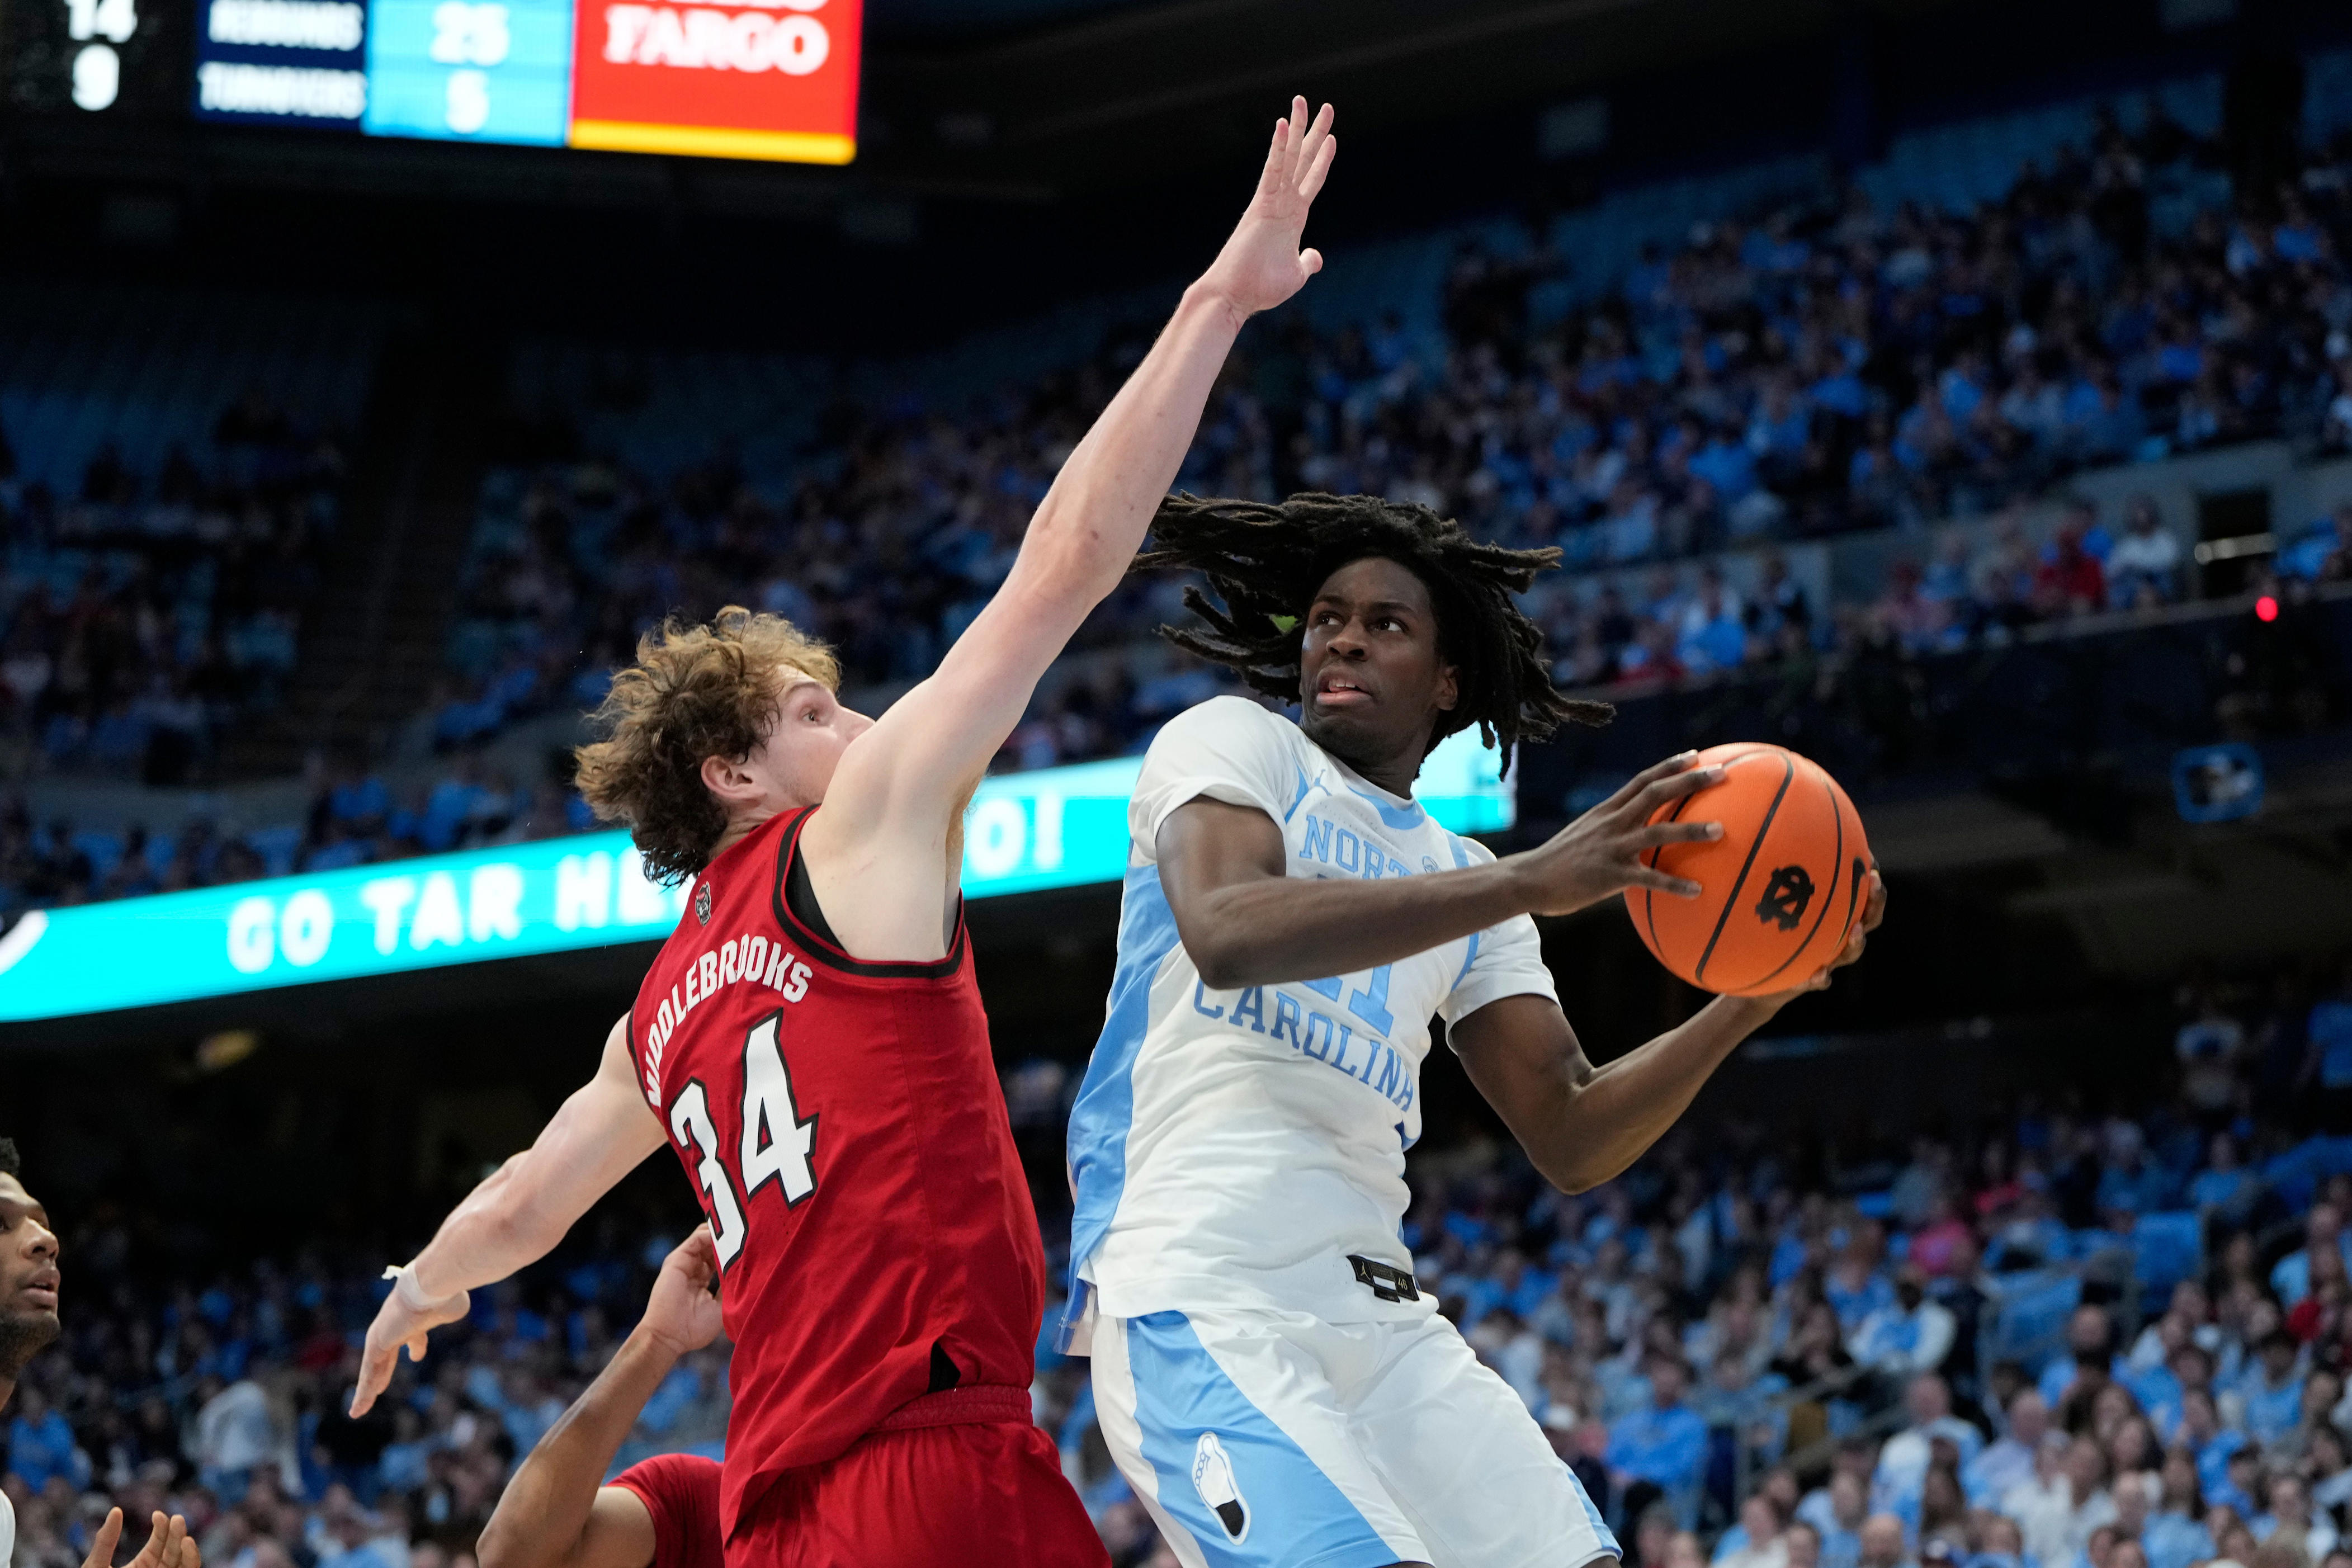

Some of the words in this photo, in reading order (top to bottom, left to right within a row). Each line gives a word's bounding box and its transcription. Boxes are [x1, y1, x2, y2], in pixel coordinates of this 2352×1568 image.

[603, 3, 830, 76] FARGO
[226, 889, 333, 974] GO
[362, 863, 523, 953] TAR
[646, 933, 813, 1108] MIDDLEBROOKS
[669, 1007, 819, 1278] 34
